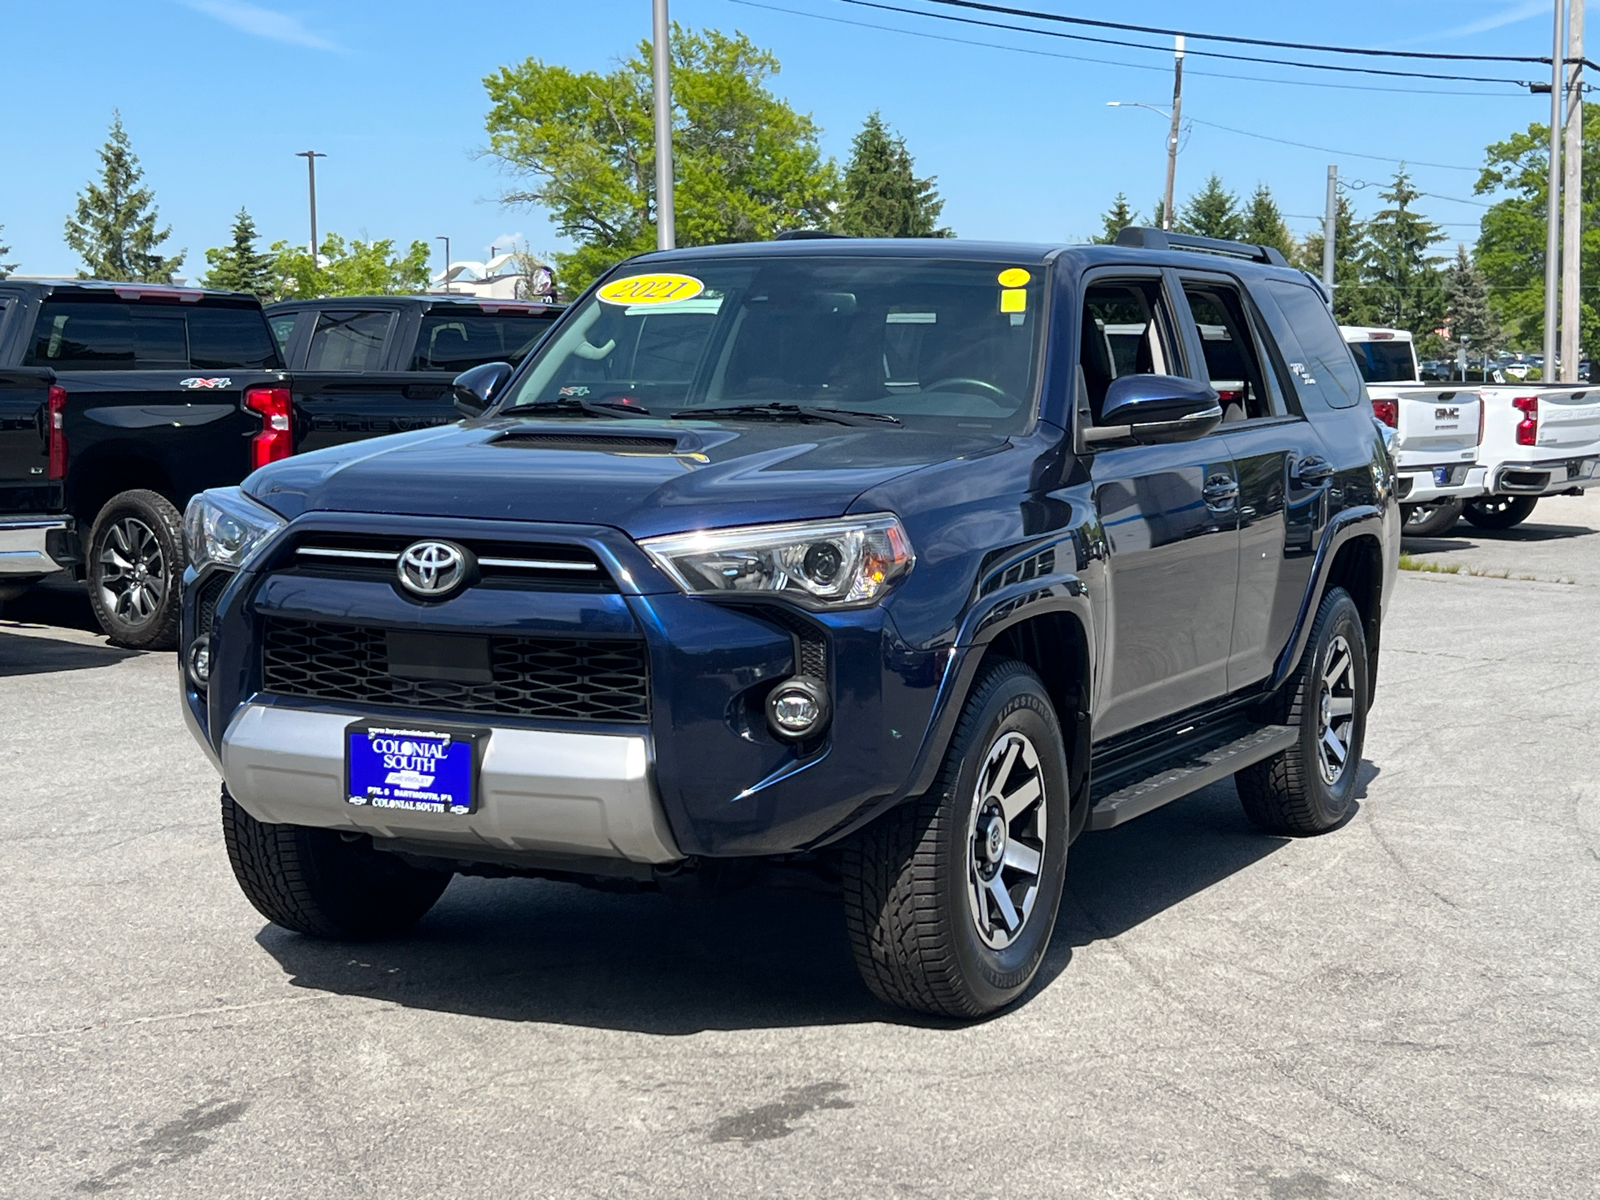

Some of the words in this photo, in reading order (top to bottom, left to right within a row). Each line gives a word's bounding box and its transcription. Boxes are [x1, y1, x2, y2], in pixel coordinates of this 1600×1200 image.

[610, 281, 689, 298] 2021
[1435, 407, 1459, 420] GMC
[372, 738, 448, 759] COLONIAL
[383, 754, 436, 773] SOUTH
[390, 774, 430, 785] CHEVROLET
[372, 797, 416, 811] COLONIAL
[416, 801, 445, 813] SOUTH
